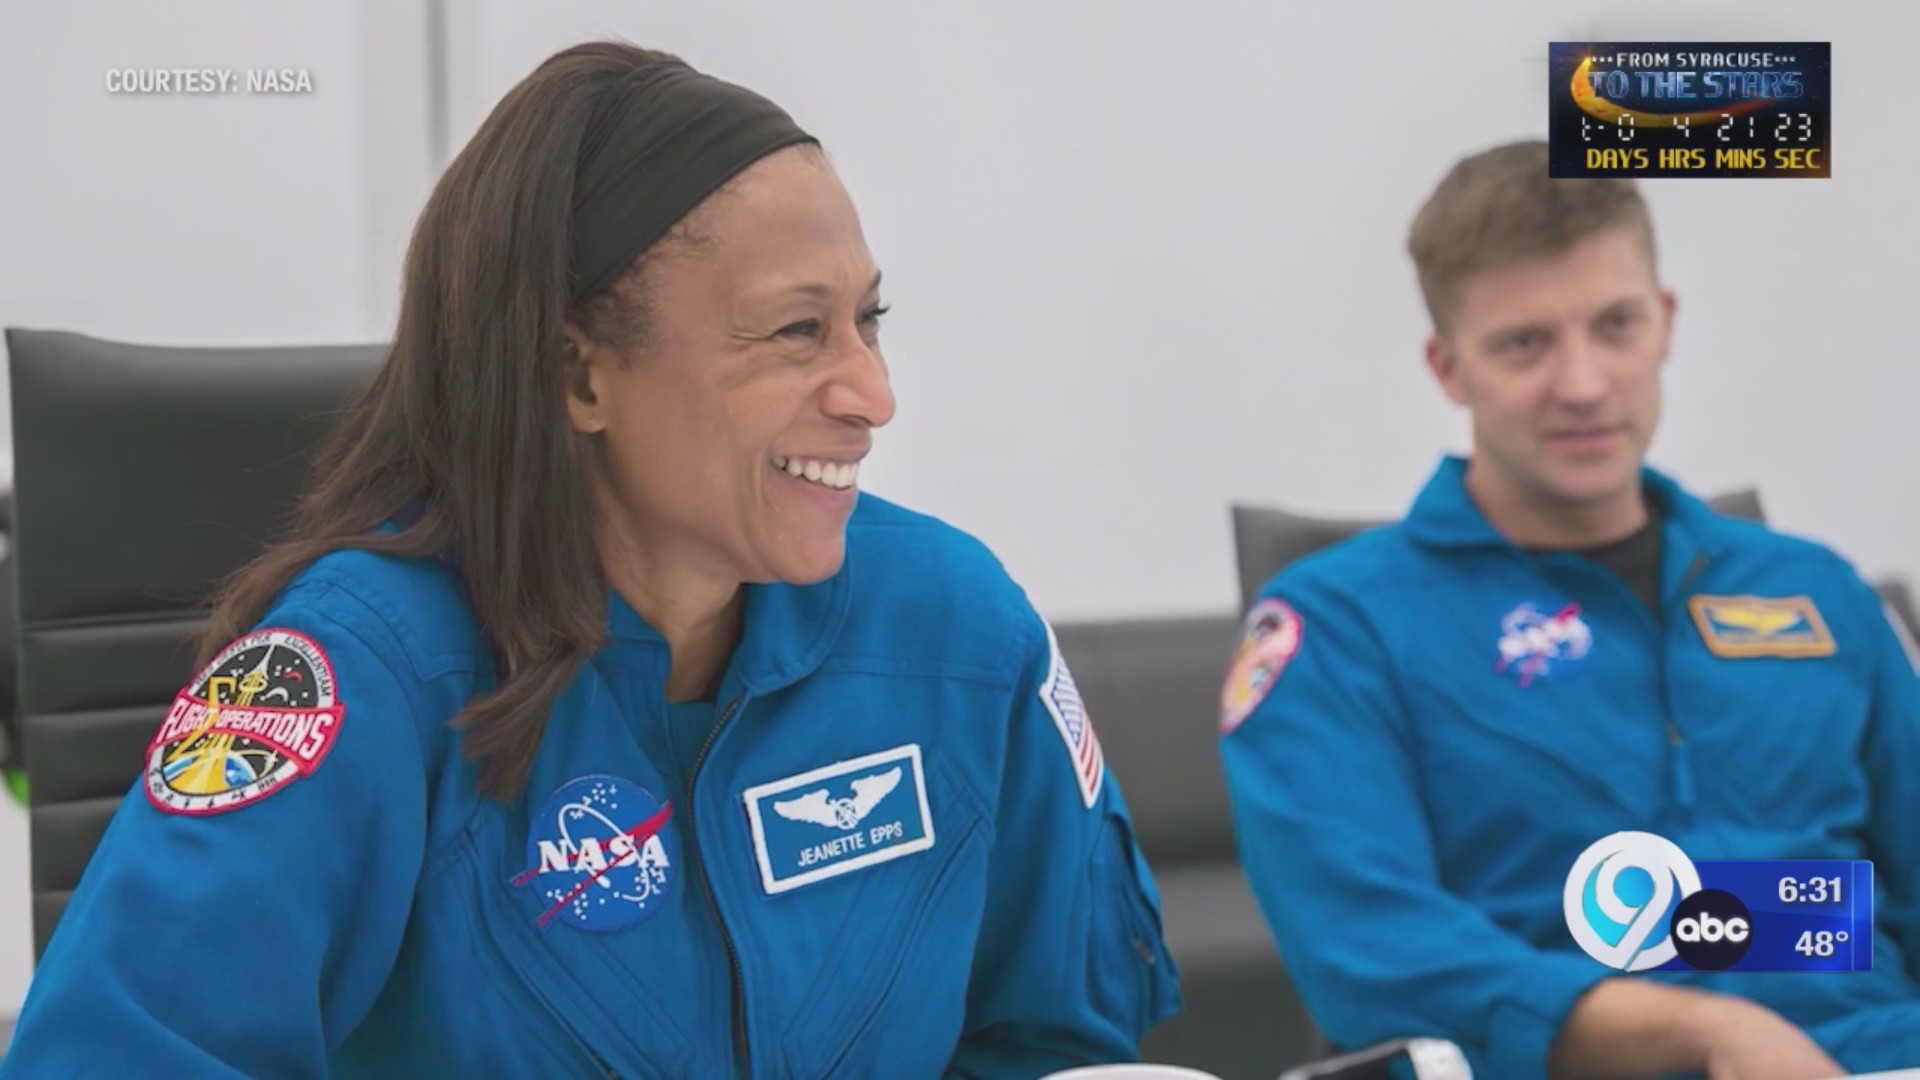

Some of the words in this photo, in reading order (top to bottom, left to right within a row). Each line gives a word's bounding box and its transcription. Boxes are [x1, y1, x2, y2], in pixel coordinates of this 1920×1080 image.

[215, 708, 335, 761] OPERATIONS
[538, 833, 670, 874] NASA
[797, 831, 866, 867] JEANETTE
[869, 820, 903, 846] EPPS
